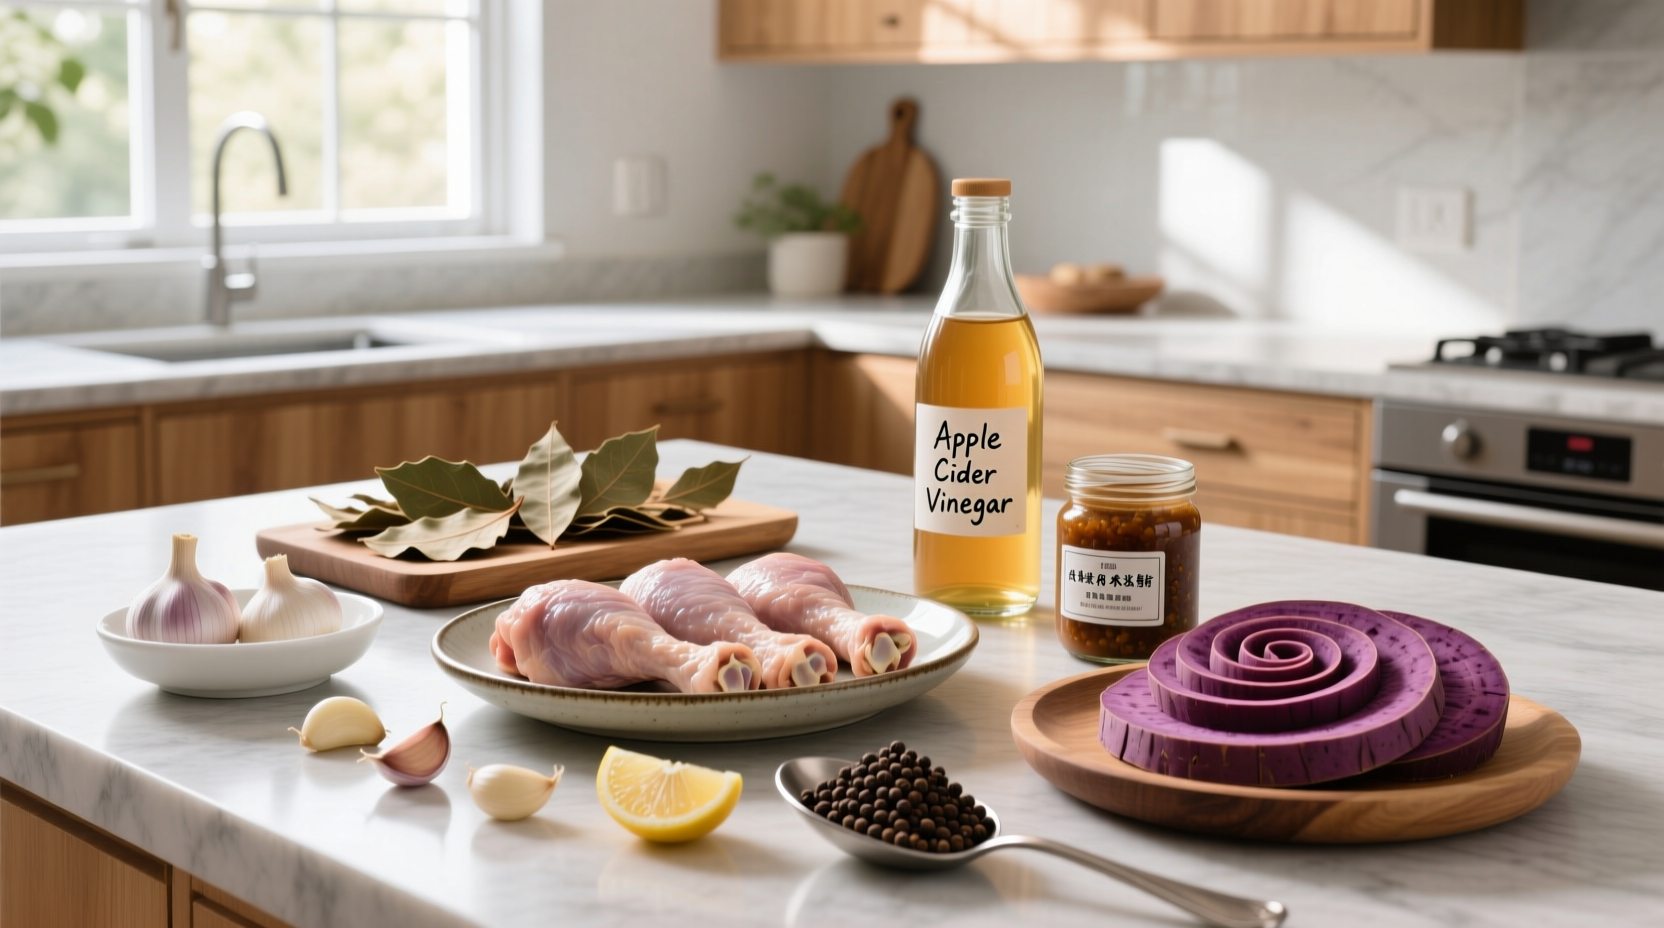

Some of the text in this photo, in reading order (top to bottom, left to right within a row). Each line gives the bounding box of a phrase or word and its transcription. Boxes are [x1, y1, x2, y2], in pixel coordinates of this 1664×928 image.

[934, 420, 1002, 459] Apple
[934, 457, 997, 484] Cider
[926, 487, 1013, 526] Vinegar
